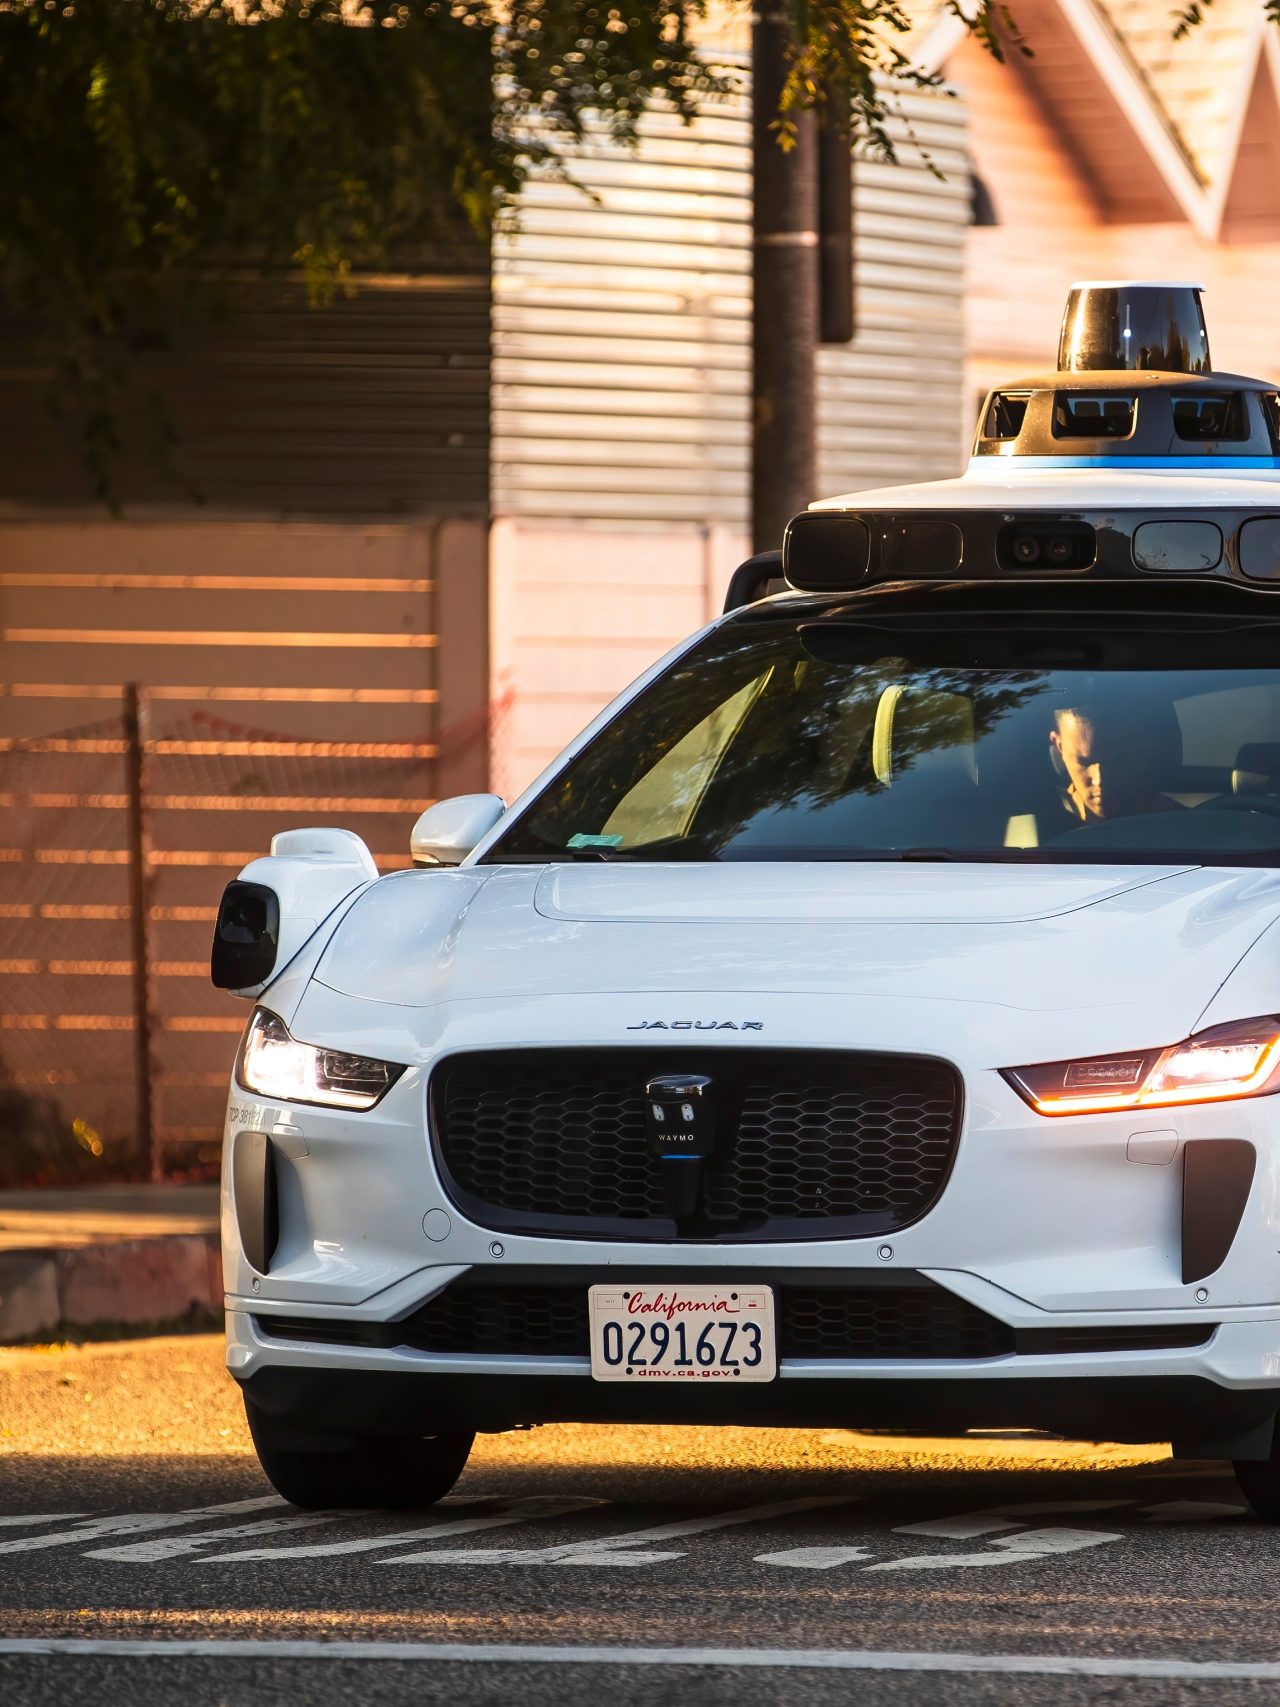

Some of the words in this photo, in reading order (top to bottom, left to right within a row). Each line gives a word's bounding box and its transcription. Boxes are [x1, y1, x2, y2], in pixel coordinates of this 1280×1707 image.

[626, 1020, 764, 1031] JAGUAR
[627, 1291, 741, 1320] California
[603, 1321, 762, 1367] 02916Z3
[638, 1369, 731, 1378] dmv.ca.gov
